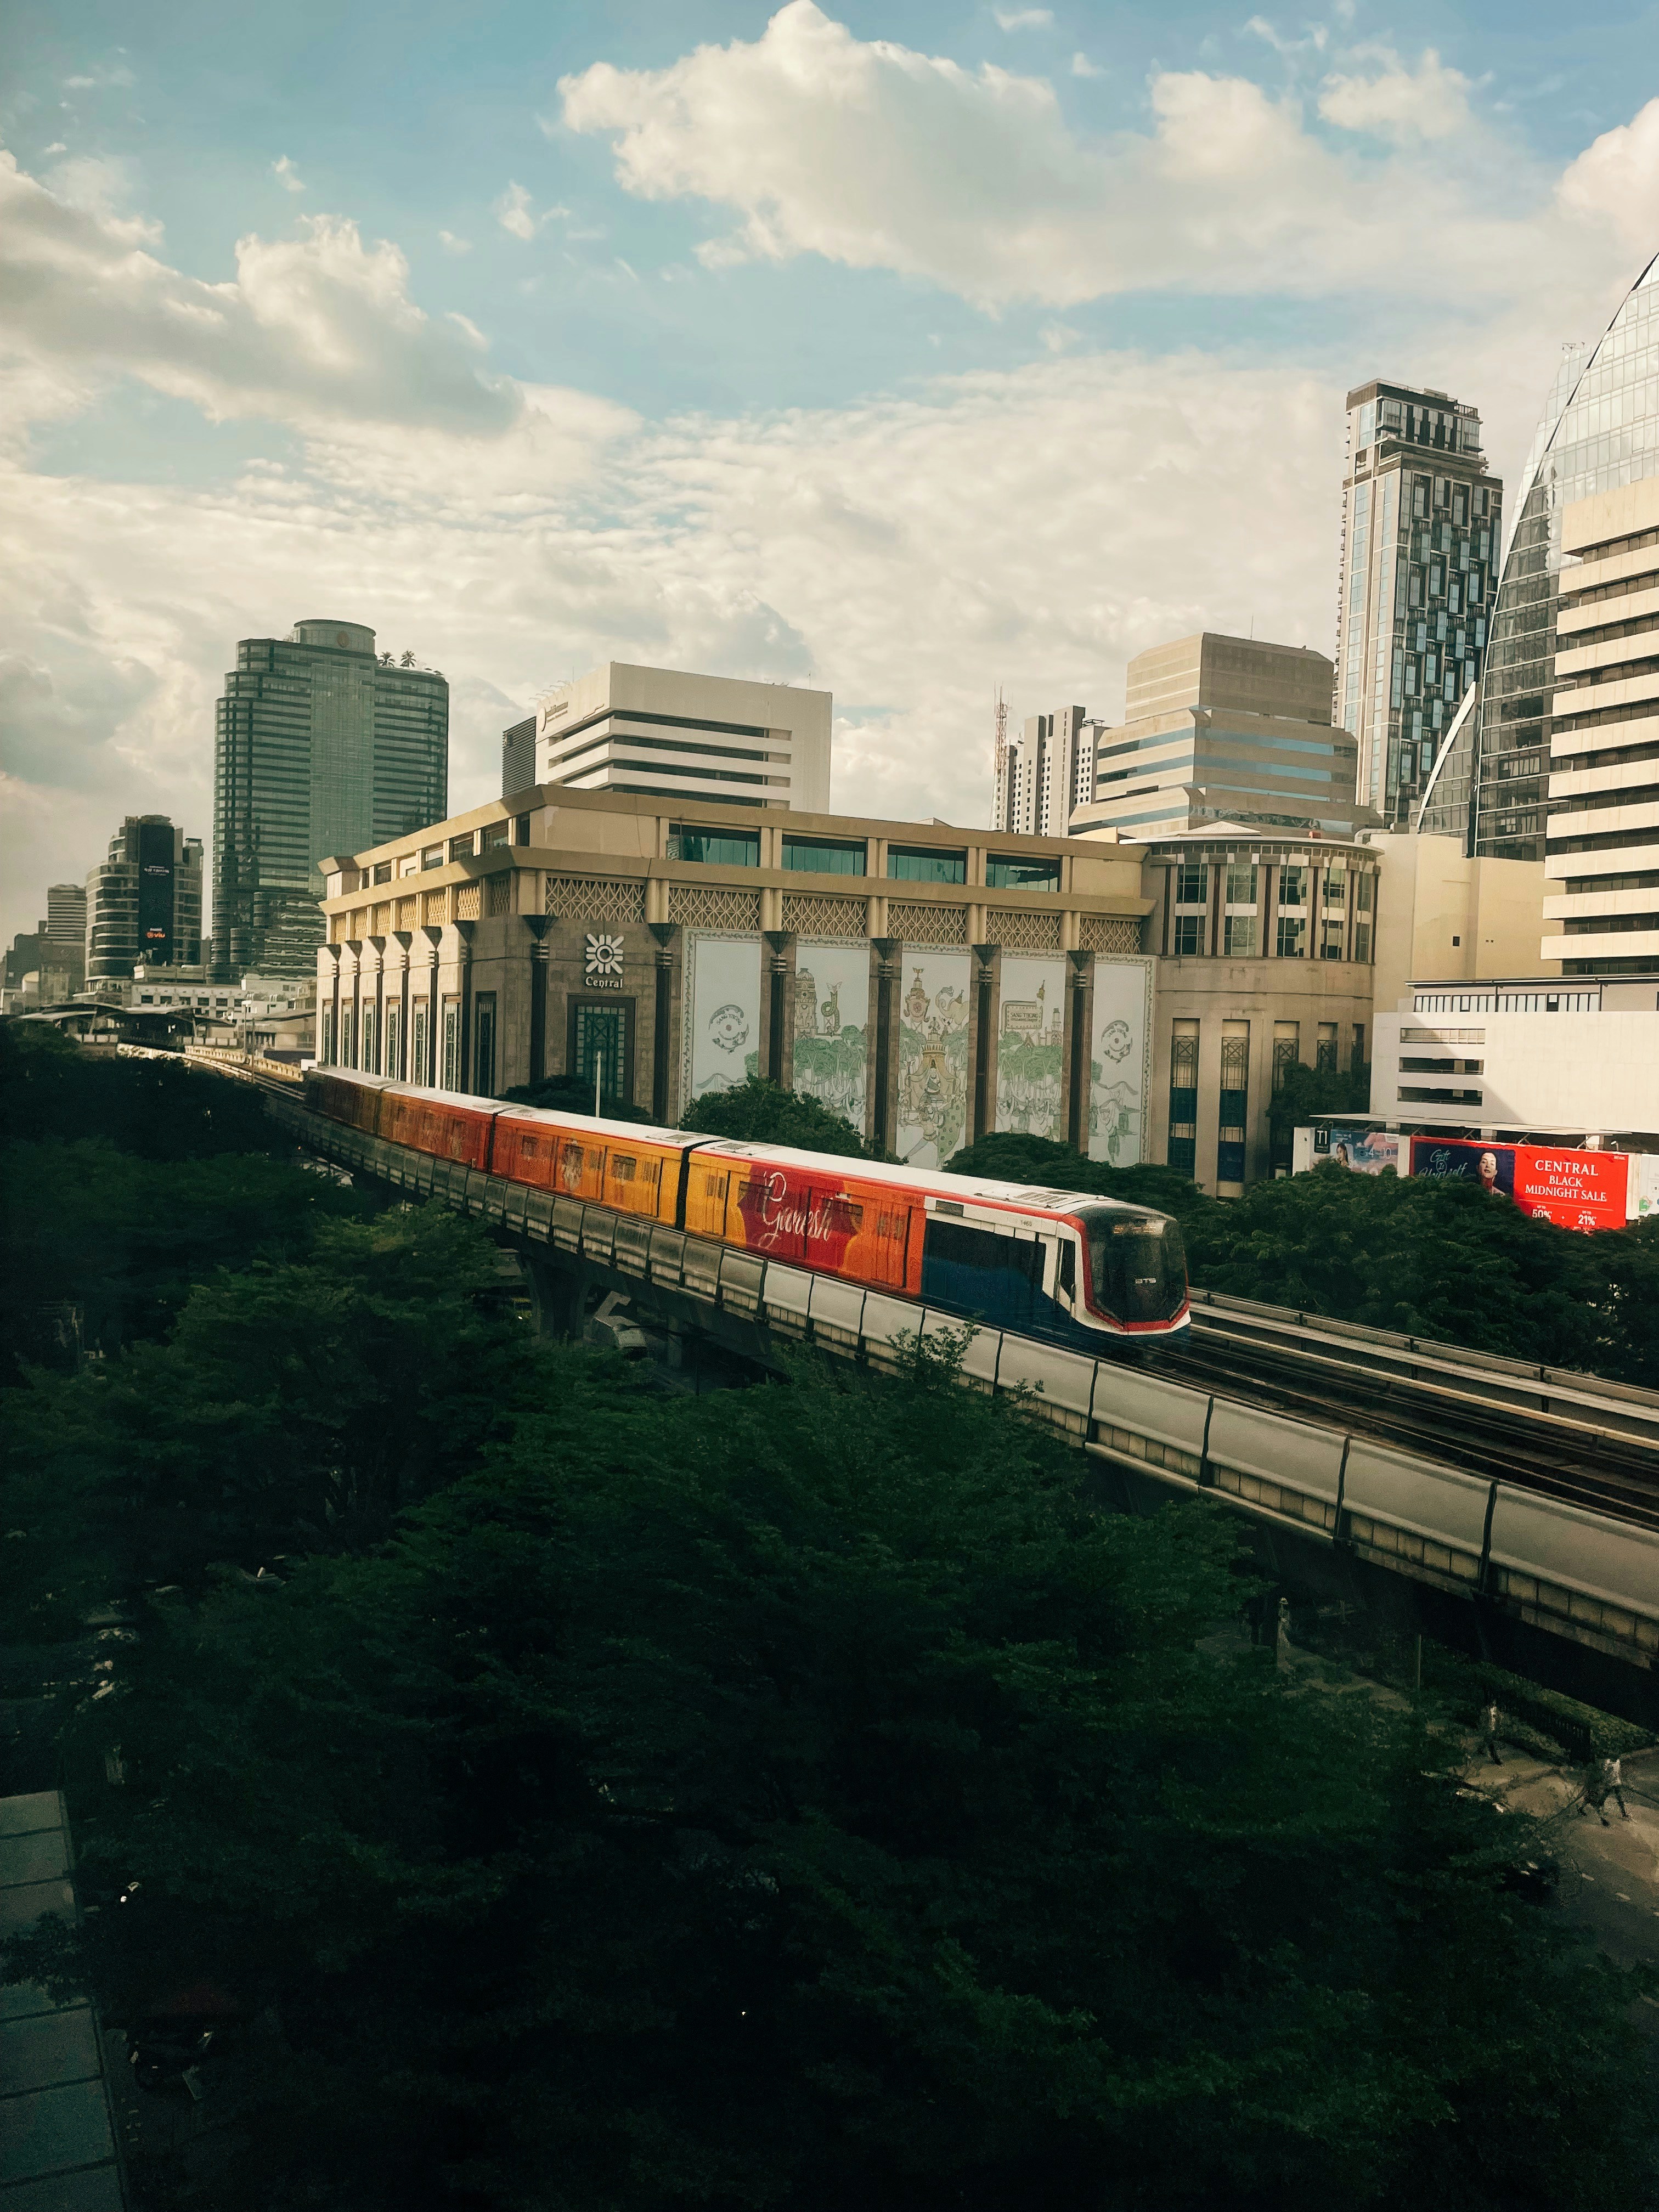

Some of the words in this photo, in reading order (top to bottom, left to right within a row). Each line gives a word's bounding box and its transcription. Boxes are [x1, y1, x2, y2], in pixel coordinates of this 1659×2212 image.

[585, 977, 623, 989] Central
[1317, 1130, 1328, 1145] T1
[1430, 1149, 1452, 1163] Gift
[1534, 1159, 1599, 1176] CENTRAL
[1549, 1175, 1583, 1188] BLACK
[1525, 1184, 1579, 1199] MIDNIGHT
[1581, 1189, 1607, 1203] SALE
